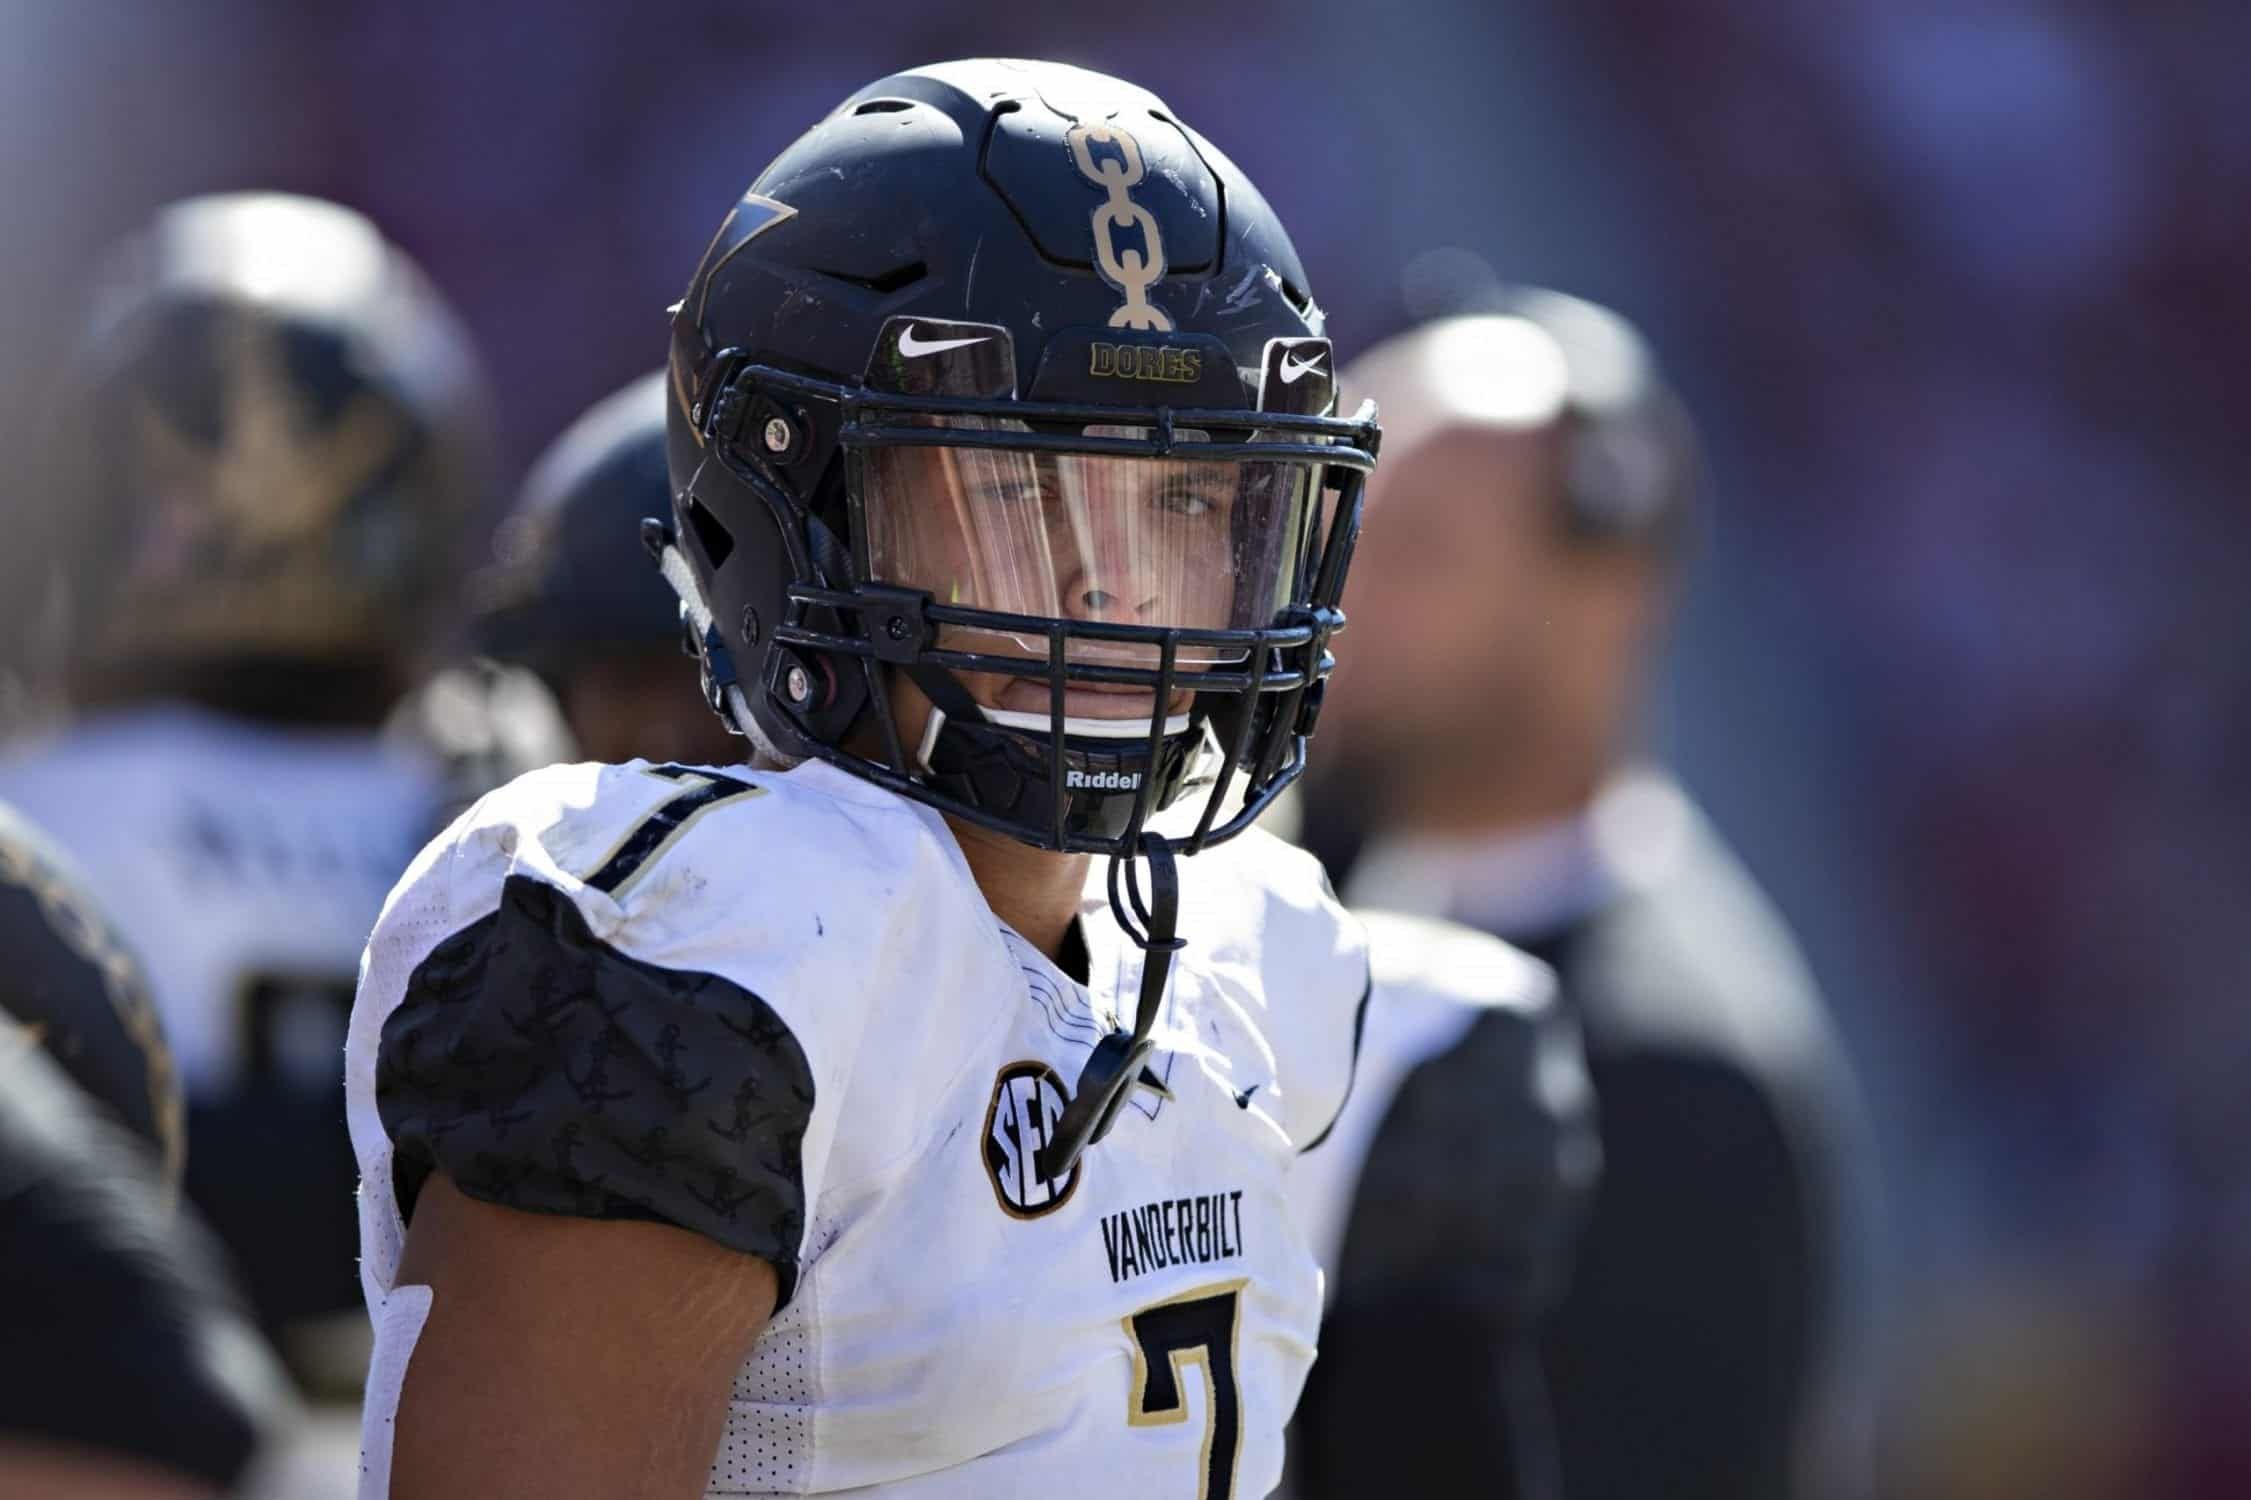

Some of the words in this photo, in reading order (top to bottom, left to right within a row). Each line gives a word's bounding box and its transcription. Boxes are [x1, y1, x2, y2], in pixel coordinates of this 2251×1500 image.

[1090, 342, 1202, 383] DORES
[582, 765, 769, 900] 7
[1101, 1190, 1243, 1283] VANDERBILT
[1122, 1278, 1249, 1500] 7
